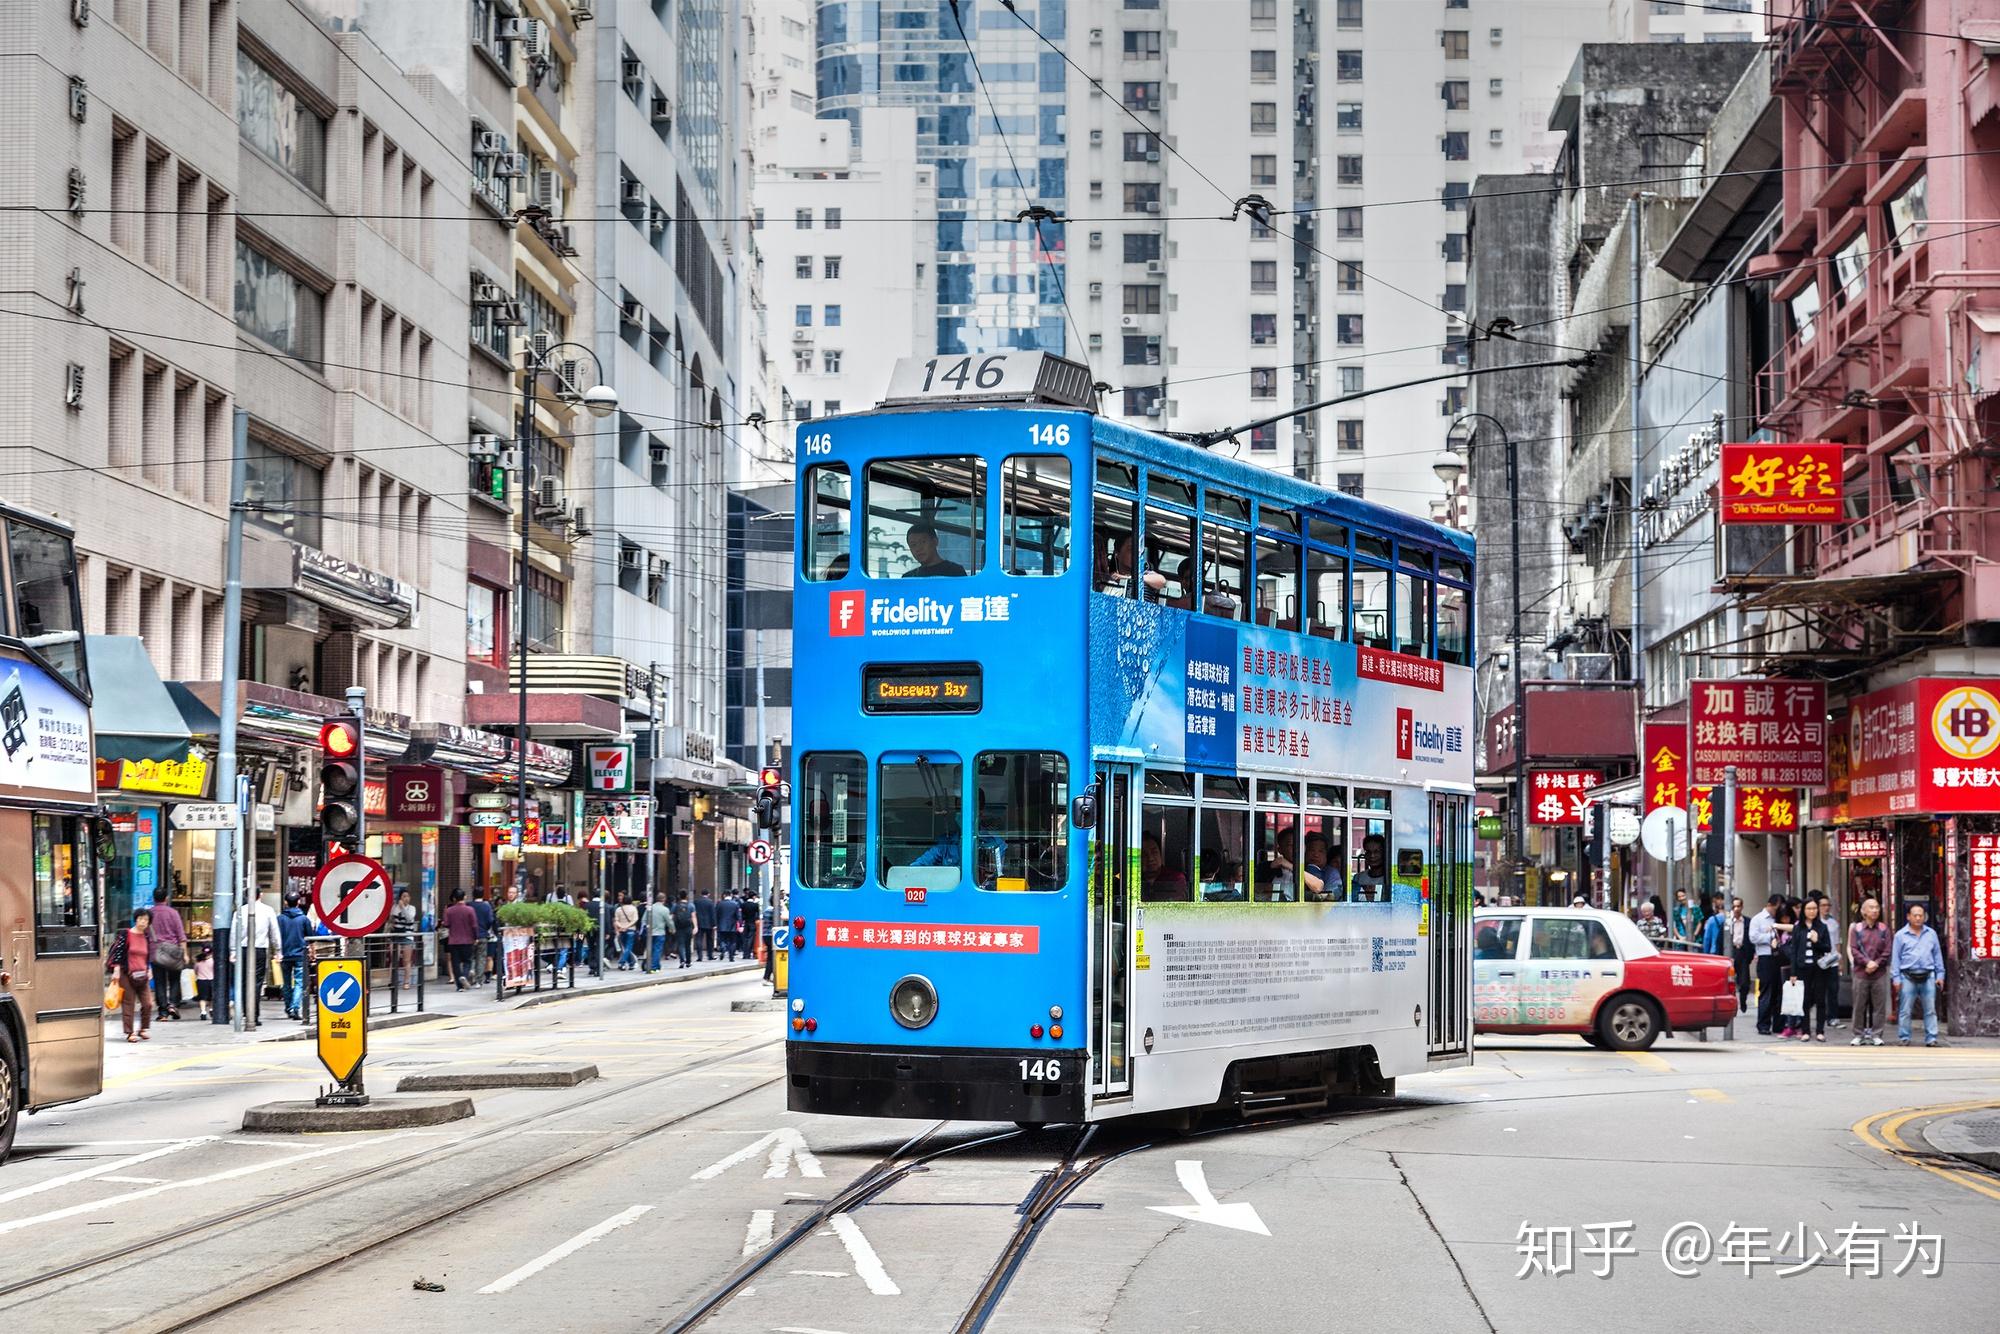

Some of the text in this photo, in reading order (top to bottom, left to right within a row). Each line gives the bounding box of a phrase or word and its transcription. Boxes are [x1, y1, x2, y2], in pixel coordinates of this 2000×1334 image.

[923, 355, 1008, 393] 146
[804, 433, 832, 455] 146
[1028, 424, 1071, 446] 146
[1730, 454, 1836, 498] 好彩
[1751, 503, 1777, 514] Finest
[1778, 503, 1807, 514] Chinese
[1807, 503, 1836, 514] Cuisine
[871, 596, 955, 626] Fidelity
[960, 595, 1010, 622] 富達
[871, 627, 954, 637] WORLDWIDE INVESTMENT
[1187, 659, 1231, 685] 卓越環球投資
[1242, 645, 1333, 687] 富達環球股息基金
[879, 681, 969, 698] Causeway Bay
[1703, 684, 1815, 717] 加誠行
[1242, 684, 1353, 727] 富達環球多元收益基金
[1187, 713, 1217, 737] 靈活掌握
[1695, 720, 1823, 746] 找換有限公司
[1951, 707, 1990, 737] HB
[1242, 723, 1310, 758] 富達世界基金
[1414, 721, 1445, 755] Fidelity
[1695, 749, 1721, 763] CASSON
[1721, 749, 1744, 763] MONEY
[1744, 749, 1763, 763] HONG
[1763, 750, 1798, 763] EXCHANGE
[1651, 745, 1682, 807] 金行
[1735, 768, 1757, 782] 9818
[1801, 768, 1823, 782] 9268
[187, 805, 226, 813] Cleverly St
[398, 802, 436, 813] 大新銀行
[1844, 831, 1881, 841] 加誠行
[906, 889, 925, 902] 020
[1671, 964, 1694, 976] 的士
[1672, 976, 1693, 987] TAXI
[331, 1021, 351, 1029] B743
[1018, 1059, 1062, 1081] 146
